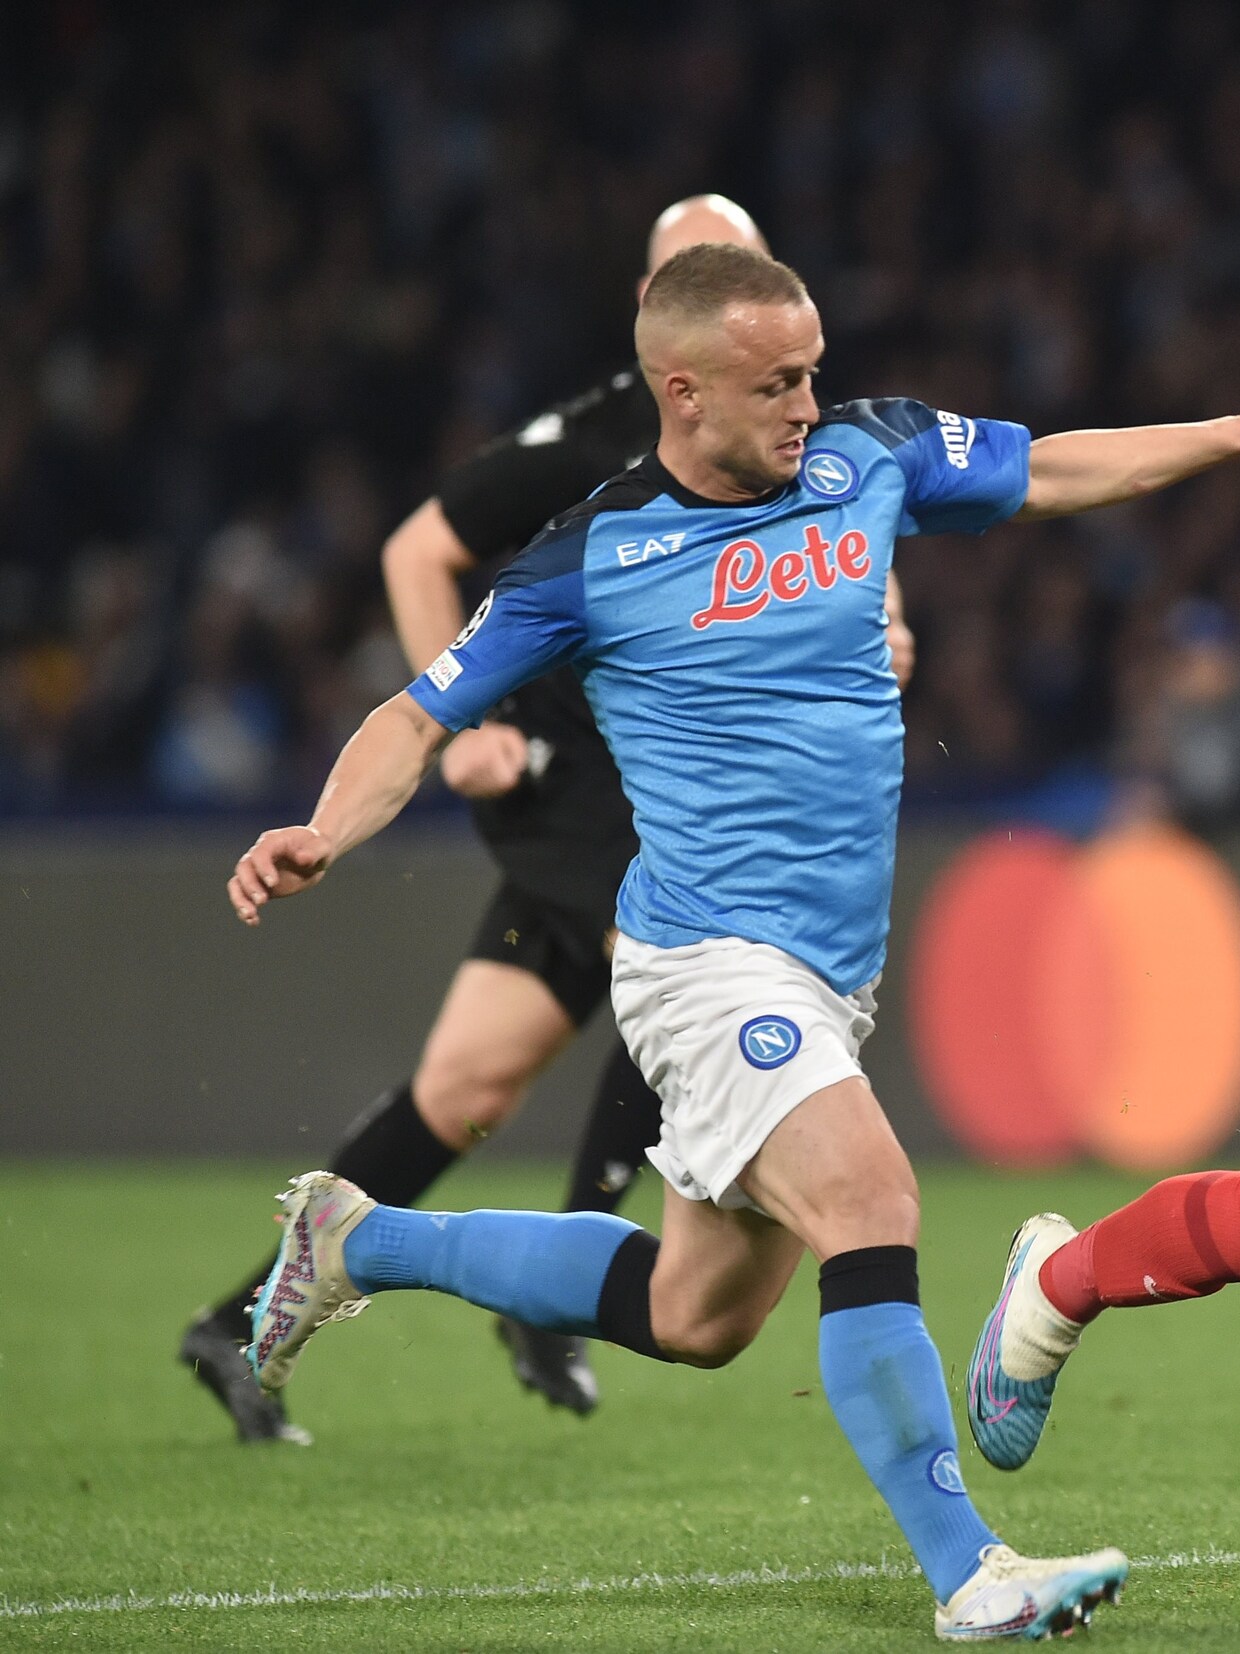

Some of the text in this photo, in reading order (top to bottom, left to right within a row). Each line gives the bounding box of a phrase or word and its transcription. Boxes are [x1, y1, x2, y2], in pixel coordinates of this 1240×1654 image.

[616, 532, 686, 567] EA7
[691, 523, 872, 631] Lete
[750, 1026, 787, 1057] N
